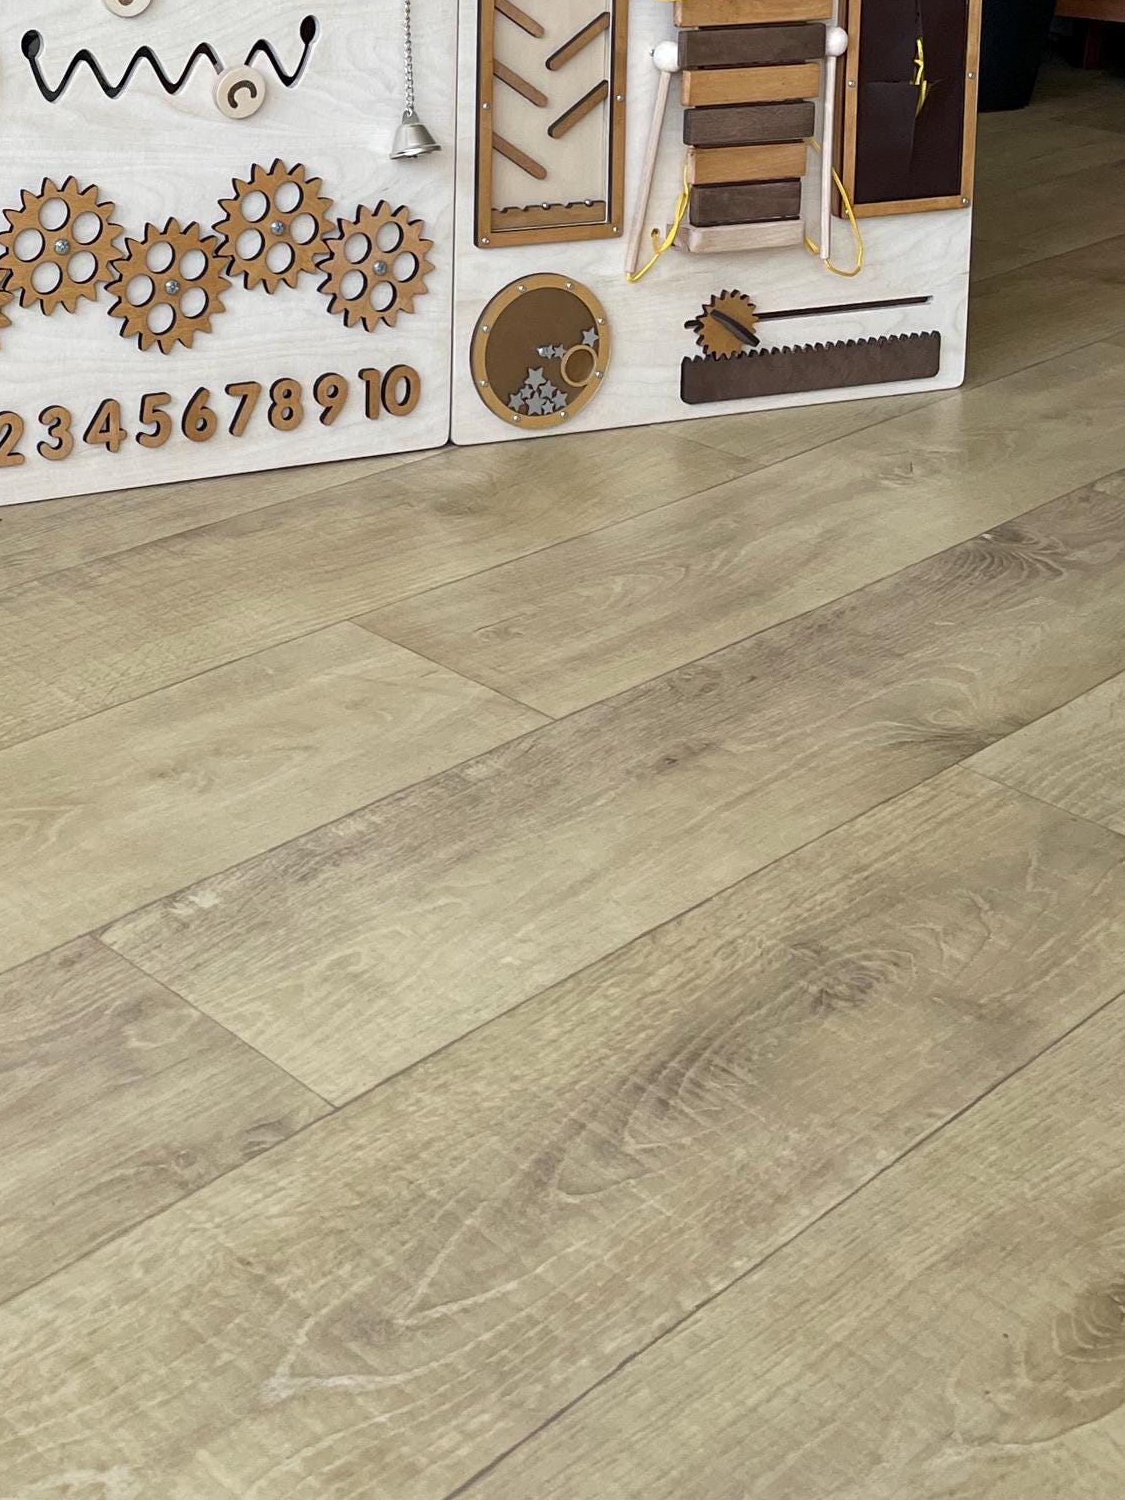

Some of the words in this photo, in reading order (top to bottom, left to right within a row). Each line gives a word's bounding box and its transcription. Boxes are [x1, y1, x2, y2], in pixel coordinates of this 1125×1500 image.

[227, 79, 258, 109] C
[36, 405, 74, 461] 3
[83, 398, 128, 453] 4
[135, 392, 173, 448] 5
[181, 386, 218, 443] 6
[224, 381, 263, 437] 7
[267, 376, 303, 432] 8
[313, 372, 349, 426] 9
[357, 364, 422, 421] 10
